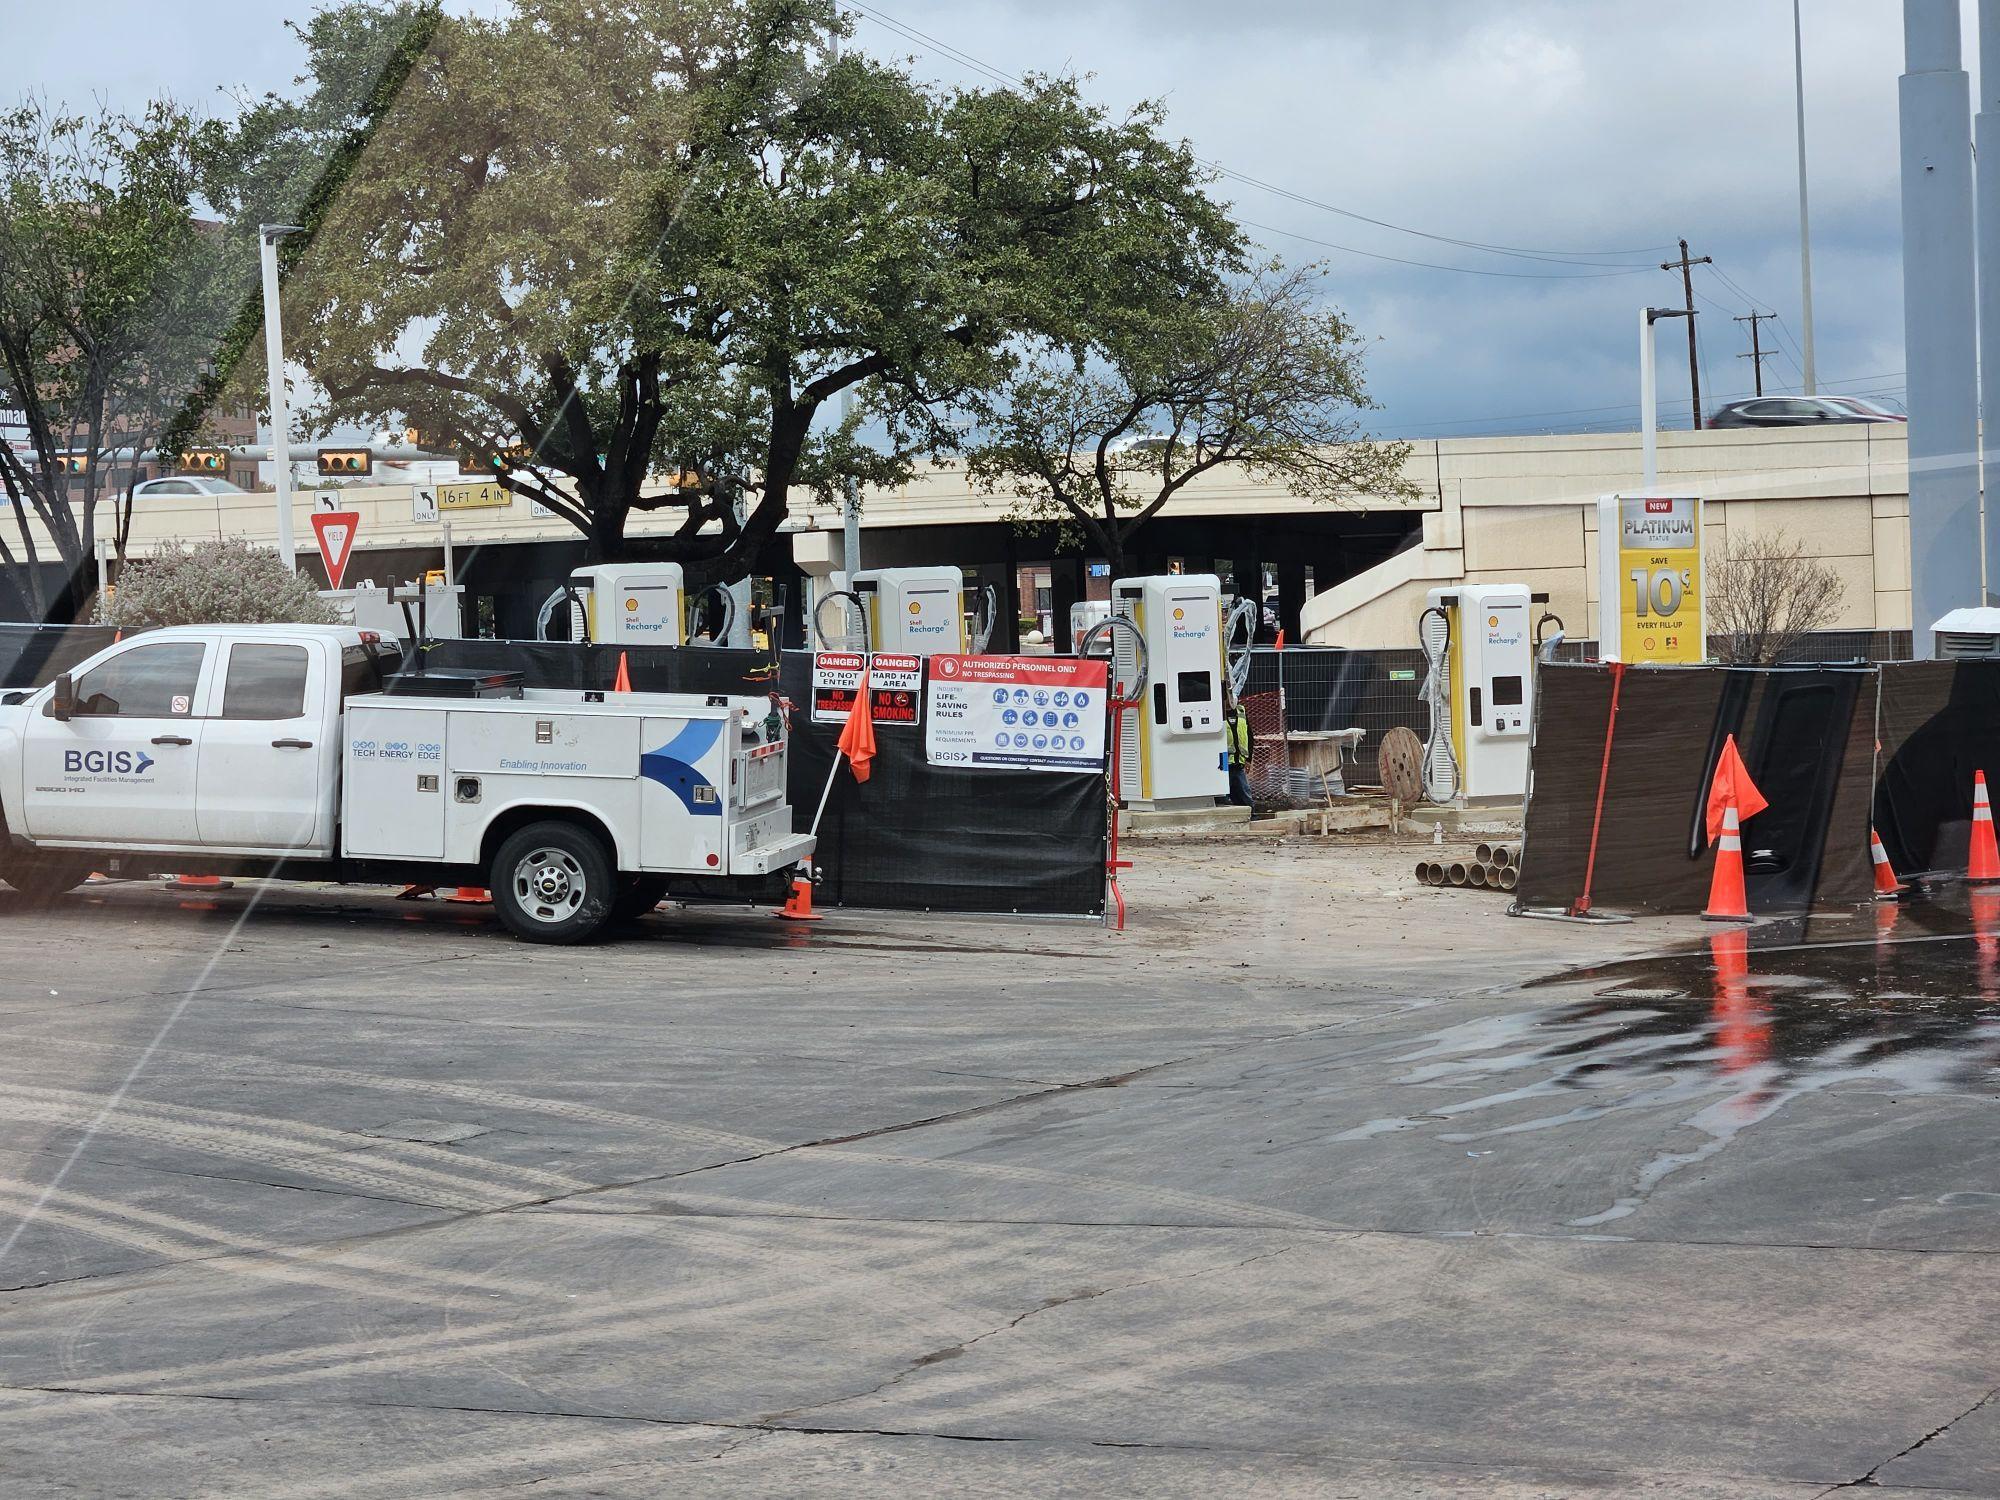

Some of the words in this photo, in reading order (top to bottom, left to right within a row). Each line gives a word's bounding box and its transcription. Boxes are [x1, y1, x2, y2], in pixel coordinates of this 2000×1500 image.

[444, 490, 456, 504] 16
[458, 492, 470, 503] FT
[480, 488, 489, 501] 4
[494, 490, 504, 501] IN
[1649, 502, 1668, 510] NEW
[416, 512, 436, 520] ONLY
[1624, 519, 1693, 534] PLATINUM
[328, 531, 343, 541] YIELD
[626, 622, 662, 631] Recharge
[909, 625, 944, 633] Recharge
[1488, 637, 1517, 645] Recharge
[820, 657, 860, 667] DANGER
[875, 659, 916, 668] DANGER
[962, 661, 1011, 669] AUTHORIZED
[1012, 663, 1056, 672] PERSONNEL
[833, 690, 845, 700] NO
[878, 692, 891, 705] NO
[936, 702, 968, 710] SAVING
[873, 706, 914, 720] SMOKING
[353, 749, 375, 757] TECH
[380, 750, 414, 758] ENERGY
[418, 752, 441, 760] EDGE
[935, 752, 960, 761] BGIS
[64, 750, 132, 774] BGIS
[500, 759, 538, 771] Enabling
[540, 761, 587, 770] Innovation
[64, 775, 92, 783] Integrated
[119, 776, 155, 785] Management
